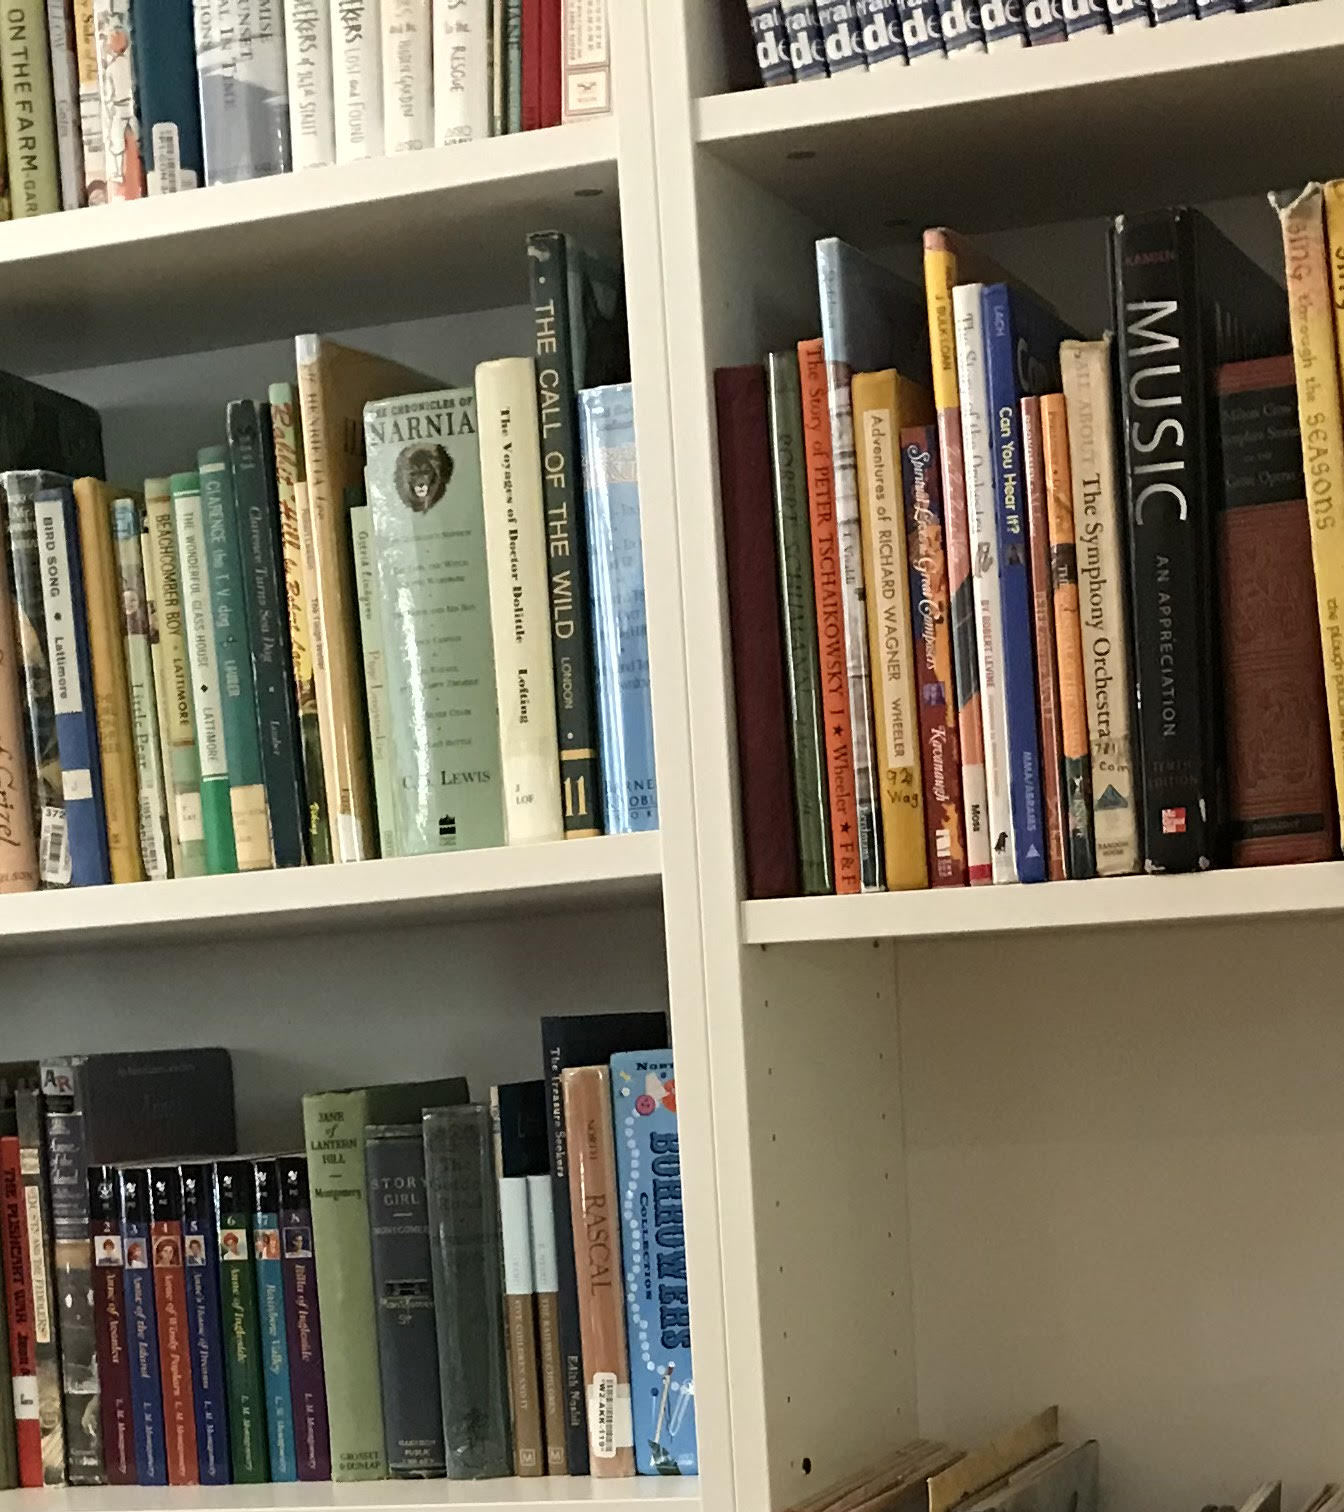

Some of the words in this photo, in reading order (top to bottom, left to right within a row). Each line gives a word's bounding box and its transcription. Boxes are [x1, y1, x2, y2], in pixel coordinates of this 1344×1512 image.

[8, 9, 26, 41] ON
[11, 48, 32, 94] THE
[535, 299, 556, 354] THE
[501, 410, 511, 437] The
[539, 369, 562, 439] CALL
[809, 388, 822, 433] Story
[999, 406, 1012, 438] Can
[1127, 301, 1189, 525] MUSIC
[370, 414, 475, 444] NARNIA
[503, 444, 514, 509] Voyages
[545, 451, 565, 488] OF
[871, 415, 887, 499] Adventures
[1001, 442, 1015, 469] You
[815, 463, 829, 525] PETER
[878, 505, 892, 522] of
[1003, 474, 1017, 511] Hear
[1083, 477, 1098, 512] The
[44, 517, 55, 553] BIRD
[507, 514, 516, 530] of
[547, 503, 570, 557] THE
[1006, 515, 1020, 535] It?
[48, 561, 60, 598] SONG
[508, 535, 520, 582] Doctor
[878, 529, 895, 598] RICHARD
[1085, 522, 1104, 631] Symphony
[1155, 555, 1170, 582] AN
[158, 517, 176, 608] BEACHCOMBER
[167, 614, 178, 635] BOY
[174, 659, 189, 725] LATTIMORE
[513, 587, 523, 645] Dolittle
[553, 570, 575, 641] WILD
[54, 637, 68, 698] Lattimore
[885, 608, 900, 681] WAGNER
[1158, 593, 1176, 736] APPRECIATION
[561, 658, 574, 710] LONDON
[1092, 639, 1111, 738] Orchestra
[892, 699, 904, 757] WHEELER
[310, 1138, 356, 1150] LANTERN
